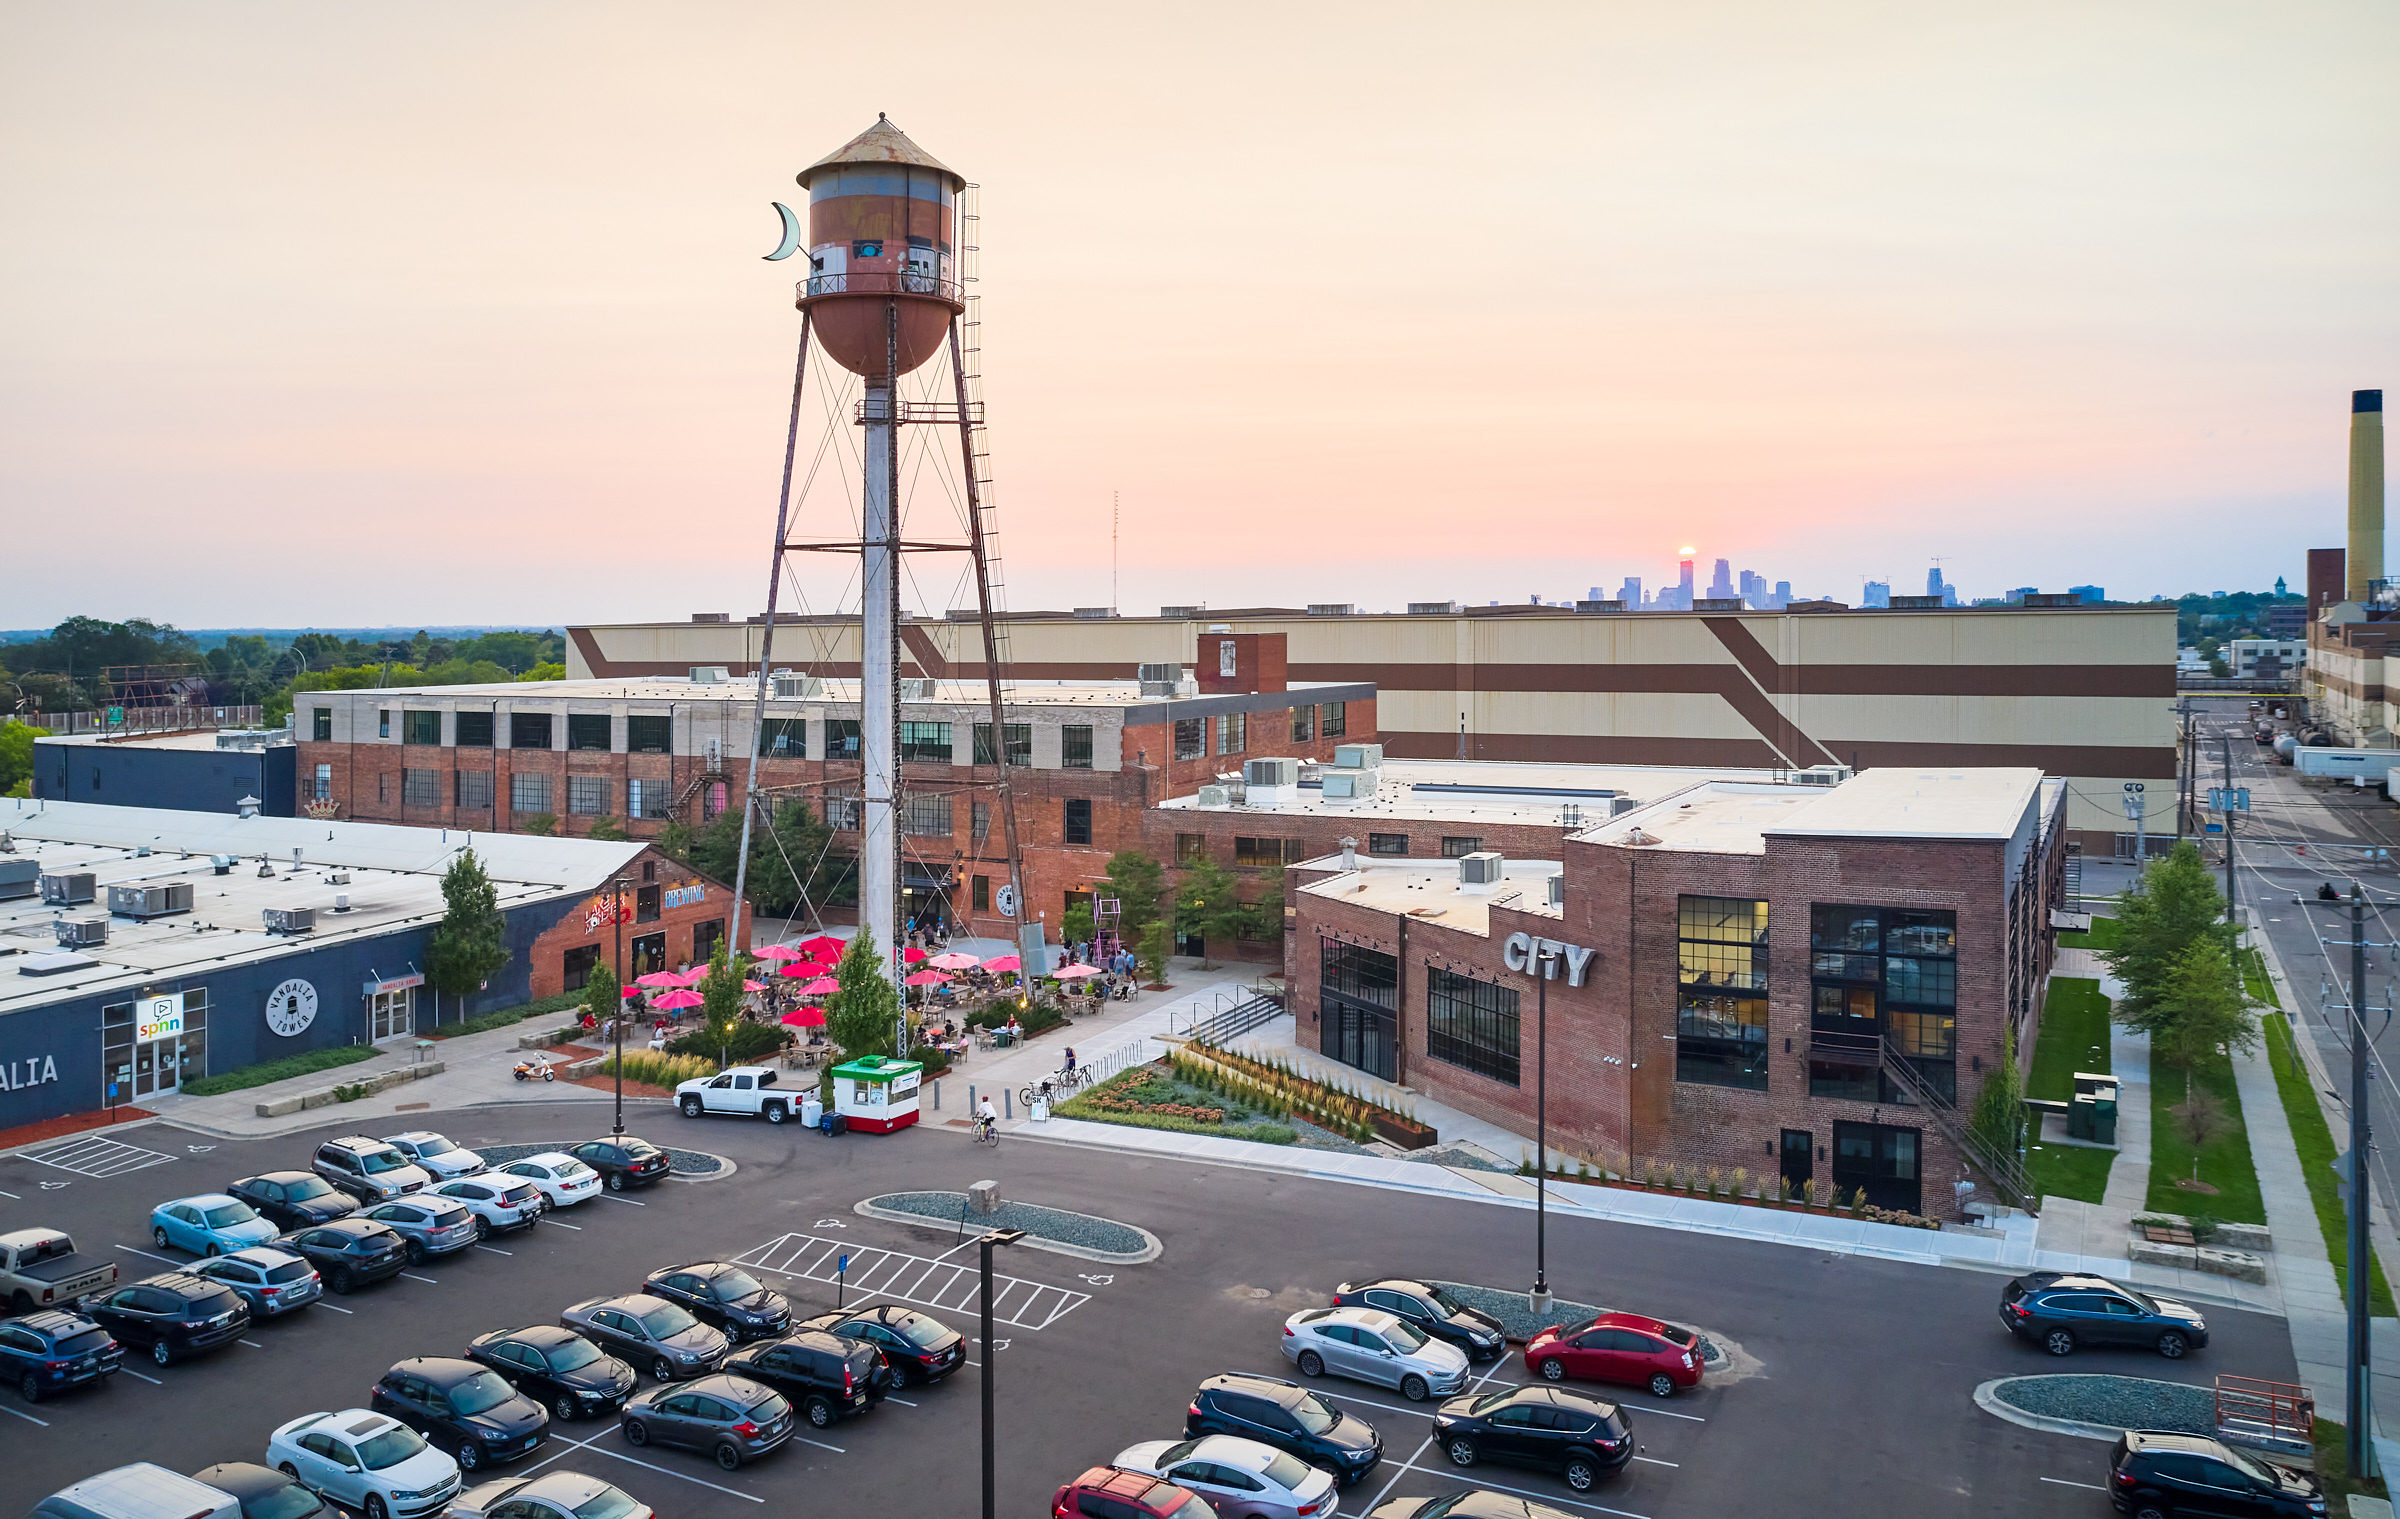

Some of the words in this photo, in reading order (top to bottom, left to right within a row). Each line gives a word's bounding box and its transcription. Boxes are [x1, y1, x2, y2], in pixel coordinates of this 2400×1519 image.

[665, 884, 705, 909] BREWING
[585, 894, 610, 924] LAKE
[1504, 932, 1596, 987] CITY
[382, 980, 404, 990] VANDALIA
[406, 977, 419, 985] ANNEX
[270, 982, 314, 1009] VANDALIA
[140, 1018, 180, 1038] spnn
[276, 1015, 310, 1033] TOWER
[66, 1276, 102, 1291] RAM
